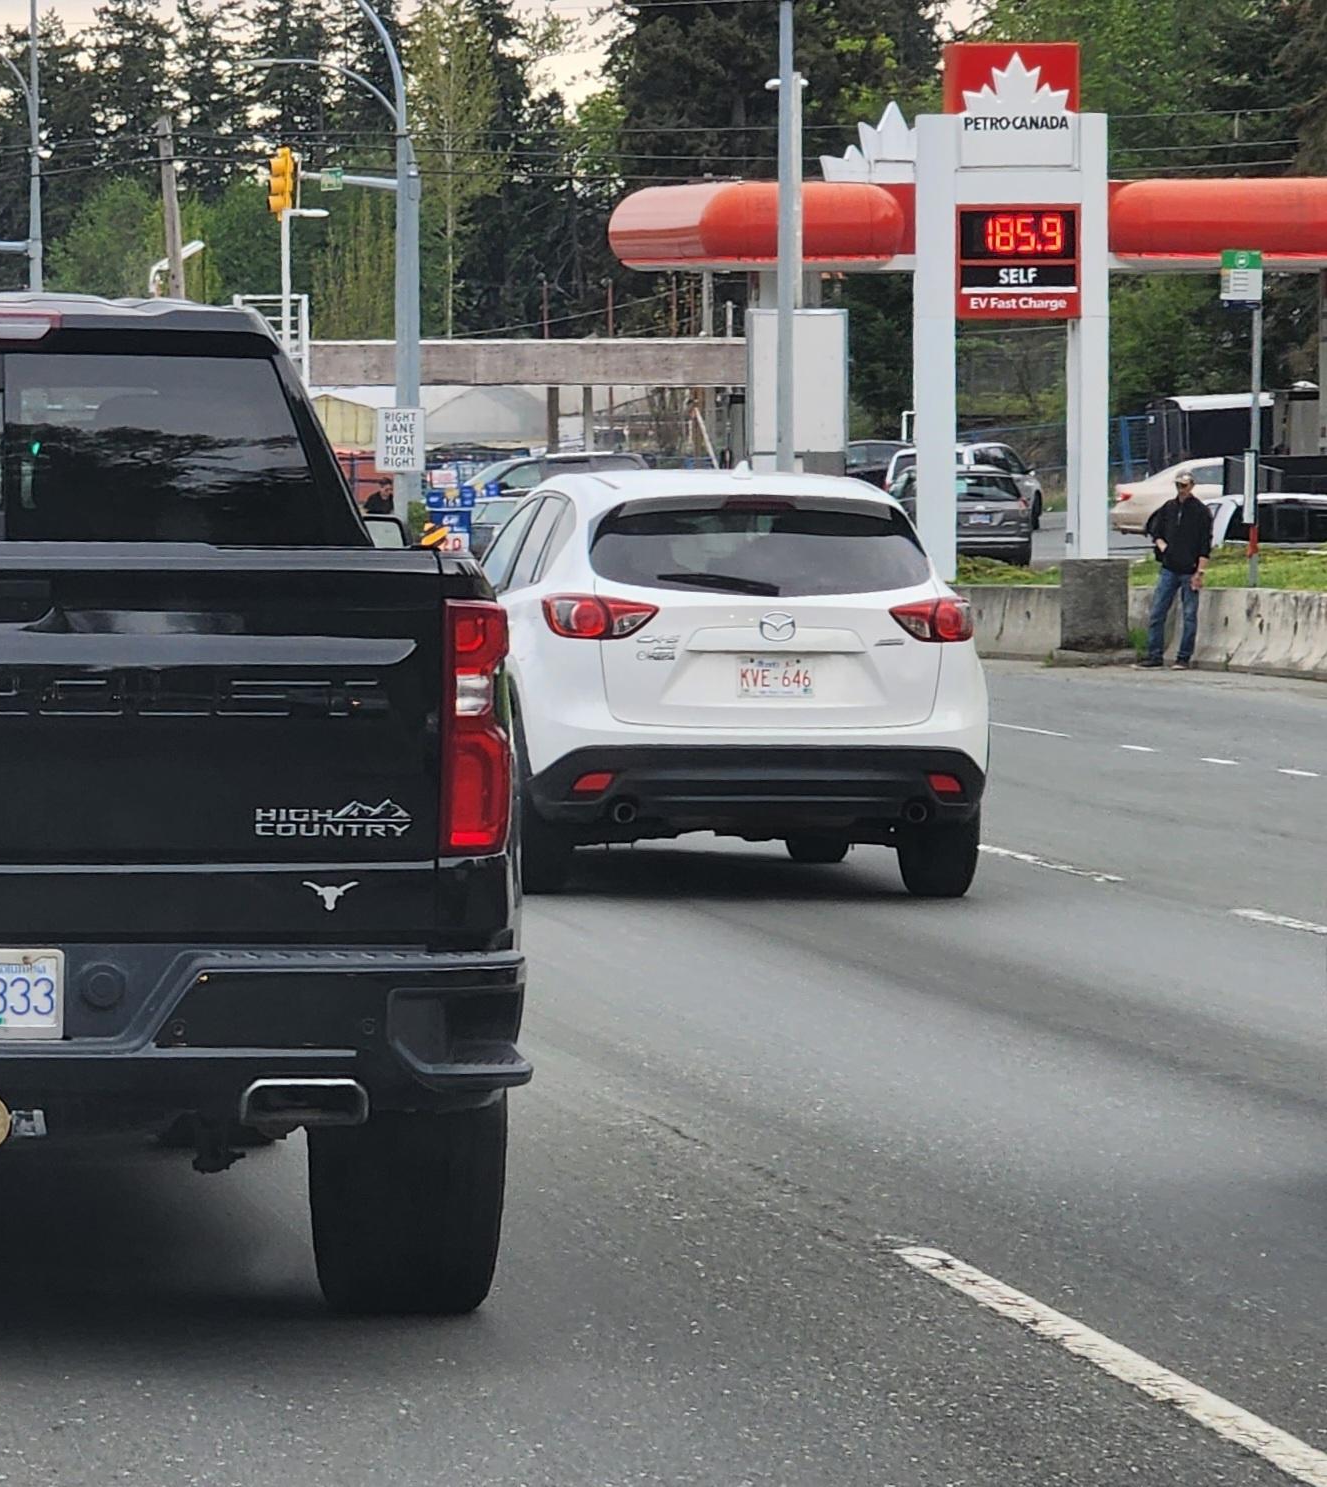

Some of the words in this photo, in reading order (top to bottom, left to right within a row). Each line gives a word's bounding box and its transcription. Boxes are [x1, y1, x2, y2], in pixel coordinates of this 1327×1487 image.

[987, 216, 1062, 251] 185.9
[998, 267, 1038, 284] SELF
[969, 297, 988, 309] EV
[990, 297, 1017, 309] Fast
[1018, 297, 1067, 312] Charge
[384, 412, 416, 422] RIGHT
[385, 423, 415, 433] LANE
[385, 435, 415, 445] MUST
[385, 446, 415, 456] TURN
[383, 457, 416, 467] RIGHT
[740, 669, 812, 688] KVE-646
[255, 808, 333, 822] HIGH
[255, 823, 411, 837] COUNTRY
